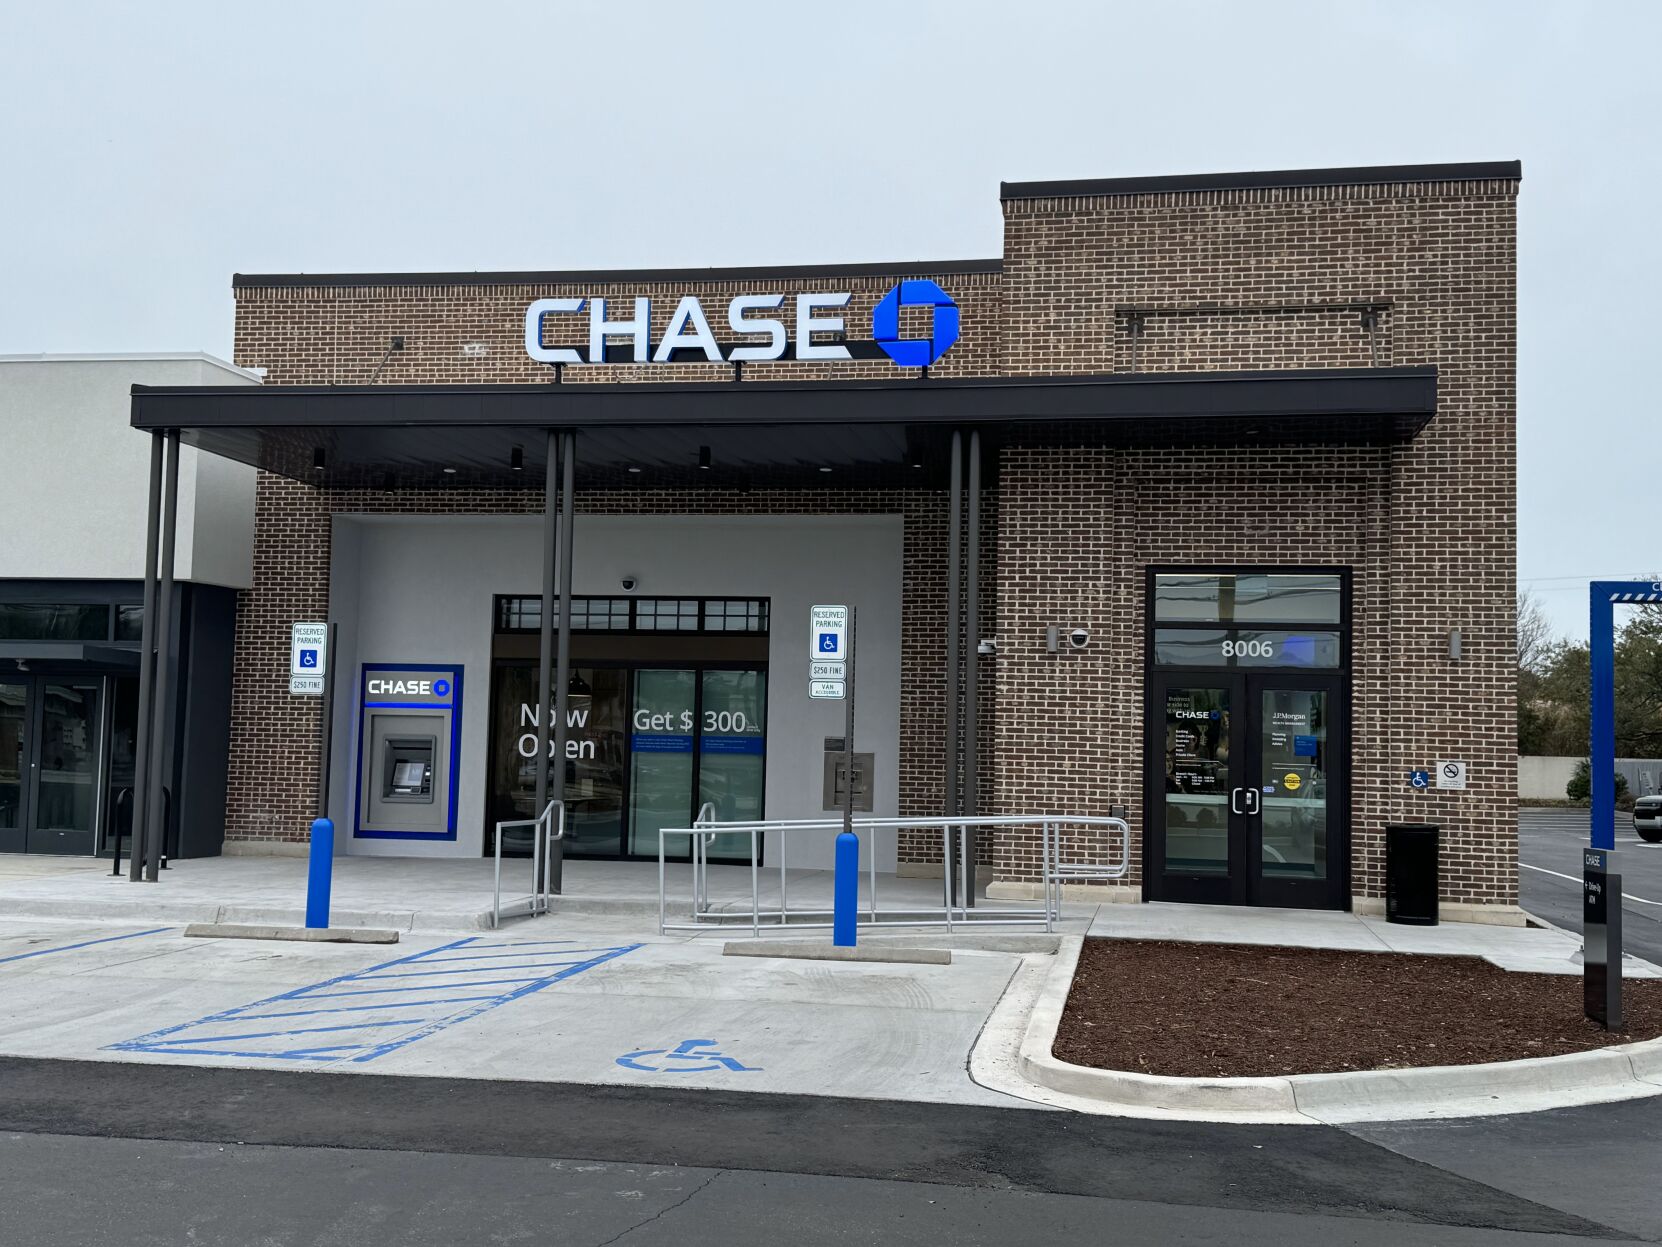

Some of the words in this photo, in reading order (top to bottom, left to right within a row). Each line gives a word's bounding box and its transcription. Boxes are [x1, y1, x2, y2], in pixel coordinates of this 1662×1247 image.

[525, 292, 852, 363] CHASE
[1652, 582, 1662, 591] C
[813, 610, 845, 619] RESERVED
[815, 620, 843, 628] PARKING
[295, 627, 325, 636] RESERVED
[296, 636, 323, 645] PARKING
[1221, 640, 1273, 657] 8006
[813, 666, 828, 675] $250
[829, 666, 843, 675] FINE
[293, 680, 307, 689] $250
[308, 681, 321, 689] FINE
[368, 679, 431, 695] CHASE
[1175, 711, 1209, 719] CHASE
[633, 709, 674, 731] Get
[1585, 854, 1600, 867] CHASE
